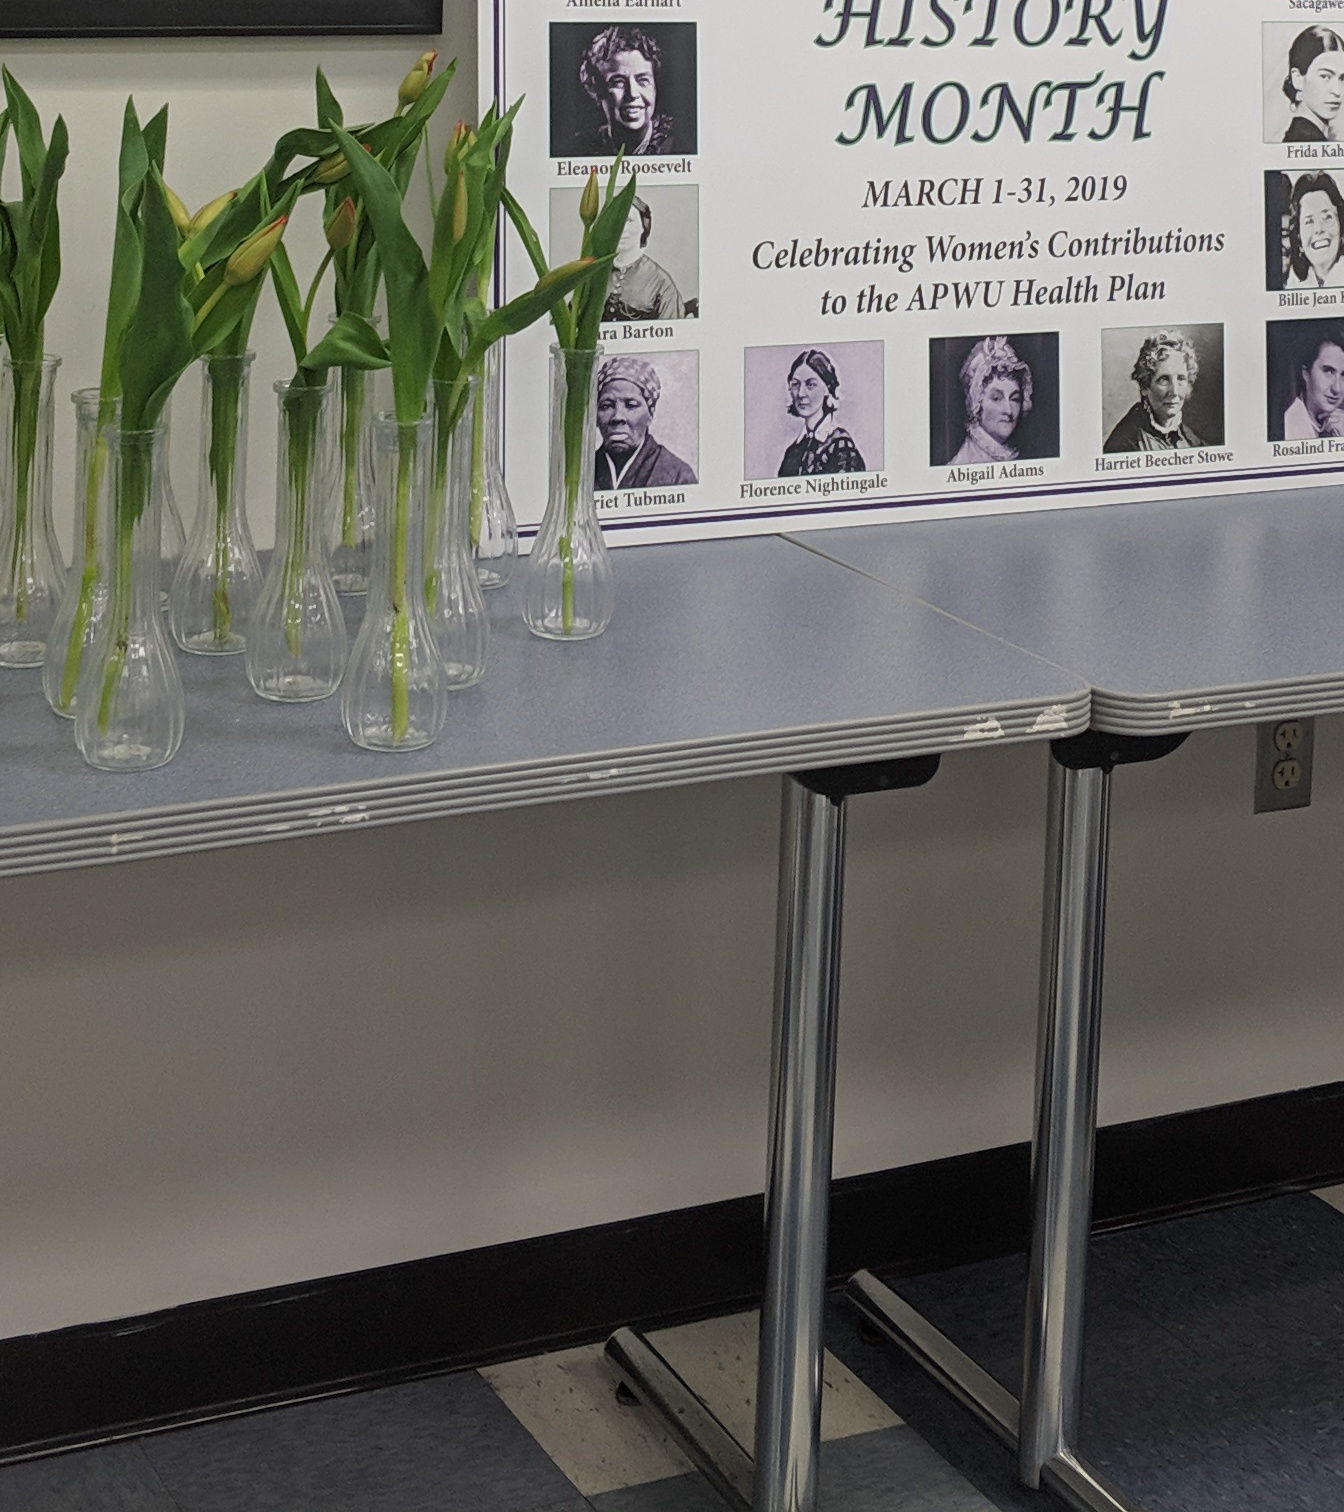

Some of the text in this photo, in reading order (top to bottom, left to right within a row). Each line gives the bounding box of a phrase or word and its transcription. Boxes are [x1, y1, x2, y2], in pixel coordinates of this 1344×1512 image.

[835, 71, 1165, 147] MONTH
[1287, 144, 1318, 158] Frida
[621, 158, 692, 174] Roosevelt
[862, 175, 1127, 208] MARCH 1-31, 2019
[752, 226, 1225, 273] Celebrating Women's Contributions
[820, 272, 1166, 315] to the APWU Health Plan
[1278, 291, 1310, 306] Billie
[1311, 291, 1338, 307] Jean
[622, 325, 673, 339] Barton
[1272, 440, 1325, 458] Rosalind
[1094, 449, 1233, 472] Harriet Beecher Stowe
[946, 463, 1044, 484] Abigail Adams
[740, 474, 888, 499] Florence Nightingale
[594, 490, 686, 509] riet Tubman
